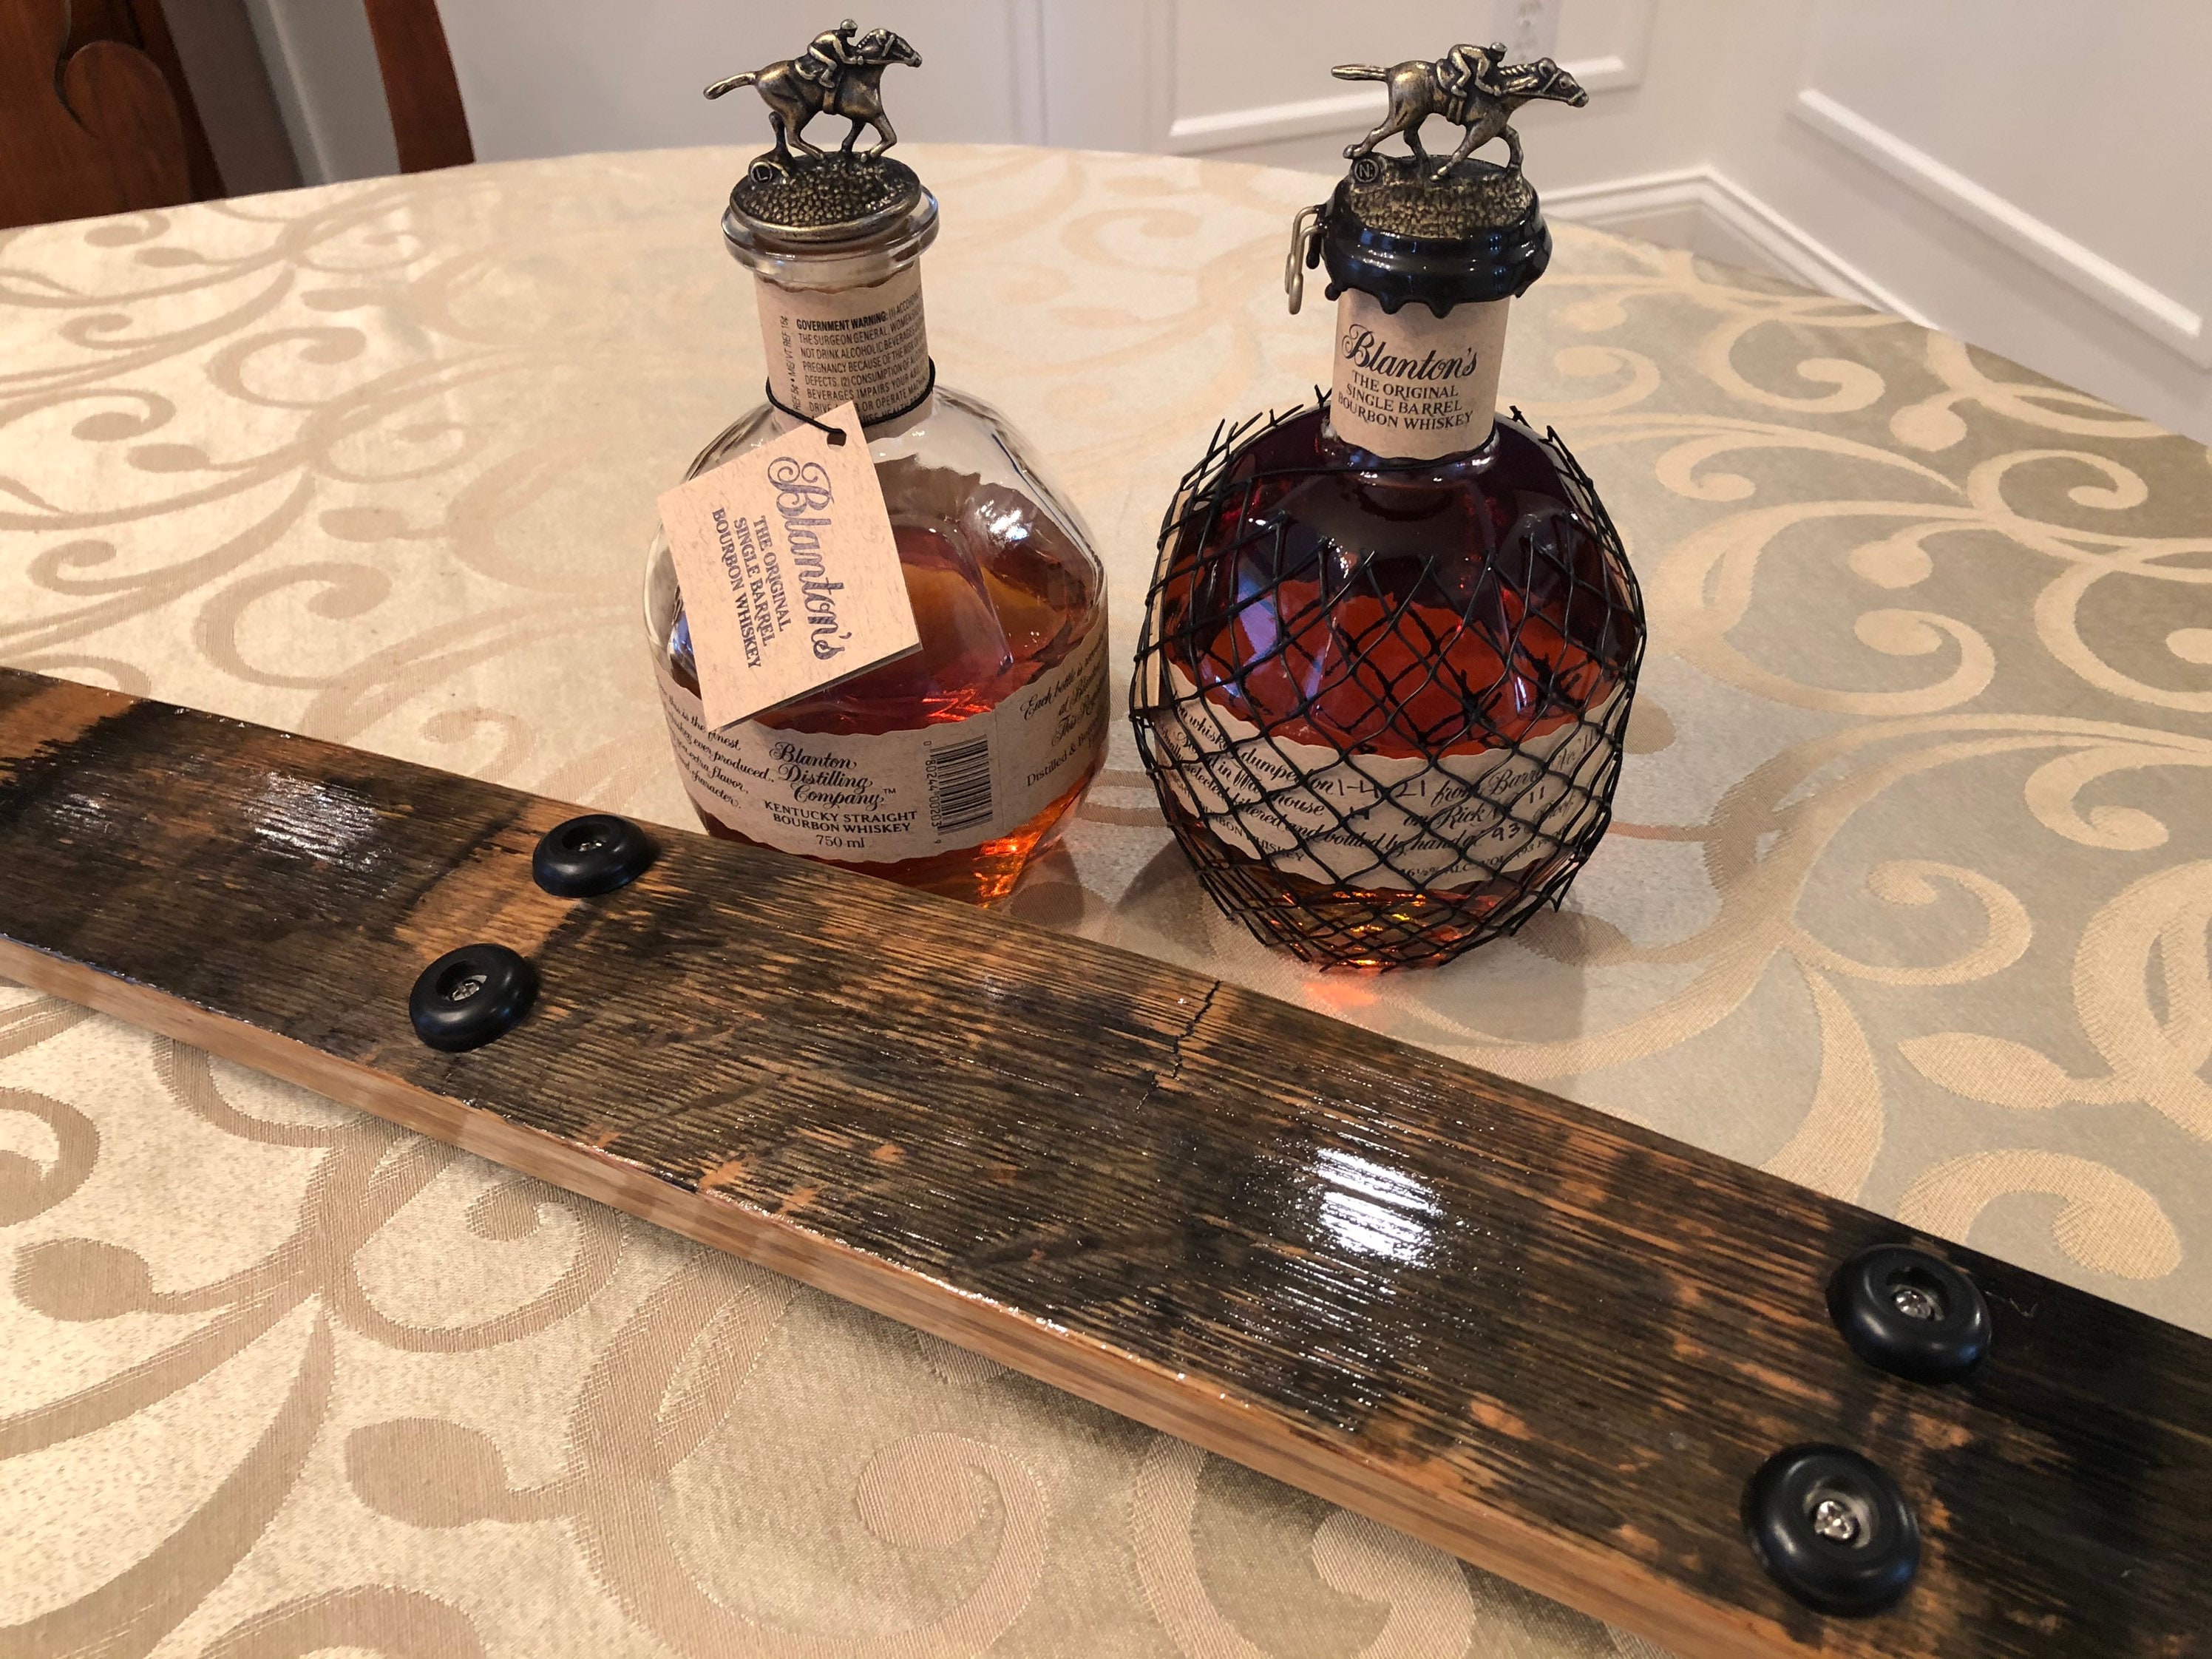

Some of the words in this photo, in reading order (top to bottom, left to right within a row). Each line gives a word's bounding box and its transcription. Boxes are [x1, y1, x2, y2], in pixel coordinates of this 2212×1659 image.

[796, 319, 849, 331] GOVERNMENT
[850, 311, 889, 330] WARNING:
[798, 332, 812, 345] THE
[813, 333, 852, 346] SURGEON
[890, 313, 912, 333] WOMEN
[781, 330, 792, 347] REF
[801, 347, 814, 359] NOT
[816, 348, 840, 359] DRINK
[841, 342, 883, 359] ALCOHOLIC
[883, 325, 915, 350] BEVERAGES
[1342, 324, 1478, 381] Blanton's
[803, 361, 847, 374] PREGNANCY
[848, 357, 882, 373] BECAUSE
[883, 353, 891, 365] OF
[891, 347, 903, 361] THE
[841, 376, 850, 387] (2)
[851, 362, 902, 386] CONSUMPTION
[807, 388, 855, 401] BEVERAGES
[855, 382, 890, 399] IMPAIRS
[891, 373, 909, 389] YOUR
[1346, 382, 1394, 412] SINGLE
[1398, 400, 1462, 417] BARREL
[1352, 369, 1380, 393] THE
[1382, 382, 1459, 400] ORIGINAL
[862, 400, 874, 412] OR
[875, 388, 907, 409] OPERATE
[1337, 393, 1399, 427] BOURBON
[1404, 410, 1473, 430] WHISKEY
[753, 515, 772, 553] THE
[767, 455, 853, 661] Blanton's
[712, 507, 744, 593] BOURBON
[734, 591, 761, 669] WHISKEY
[733, 516, 761, 578] SINGLE
[749, 578, 776, 648] BARREL
[762, 552, 792, 633] ORIGINAL
[1020, 686, 1054, 721] Each
[1058, 696, 1069, 716] at
[691, 715, 706, 733] the
[708, 729, 742, 751] finest
[1051, 714, 1077, 747] This
[693, 738, 712, 755] ever
[769, 741, 858, 770] Blanton
[778, 763, 874, 795] Distilling
[1026, 750, 1068, 787] Distilled
[1068, 743, 1077, 757] &
[1218, 760, 1232, 779] in
[1311, 777, 1334, 795] on
[764, 800, 839, 822] KENTUCKY
[843, 810, 918, 824] STRAIGHT
[773, 812, 841, 832] BOURBON
[843, 822, 912, 834] WHISKEY
[1432, 802, 1486, 830] Rick
[815, 834, 843, 849] 750
[846, 838, 866, 849] ml
[1491, 822, 1521, 841] 93
